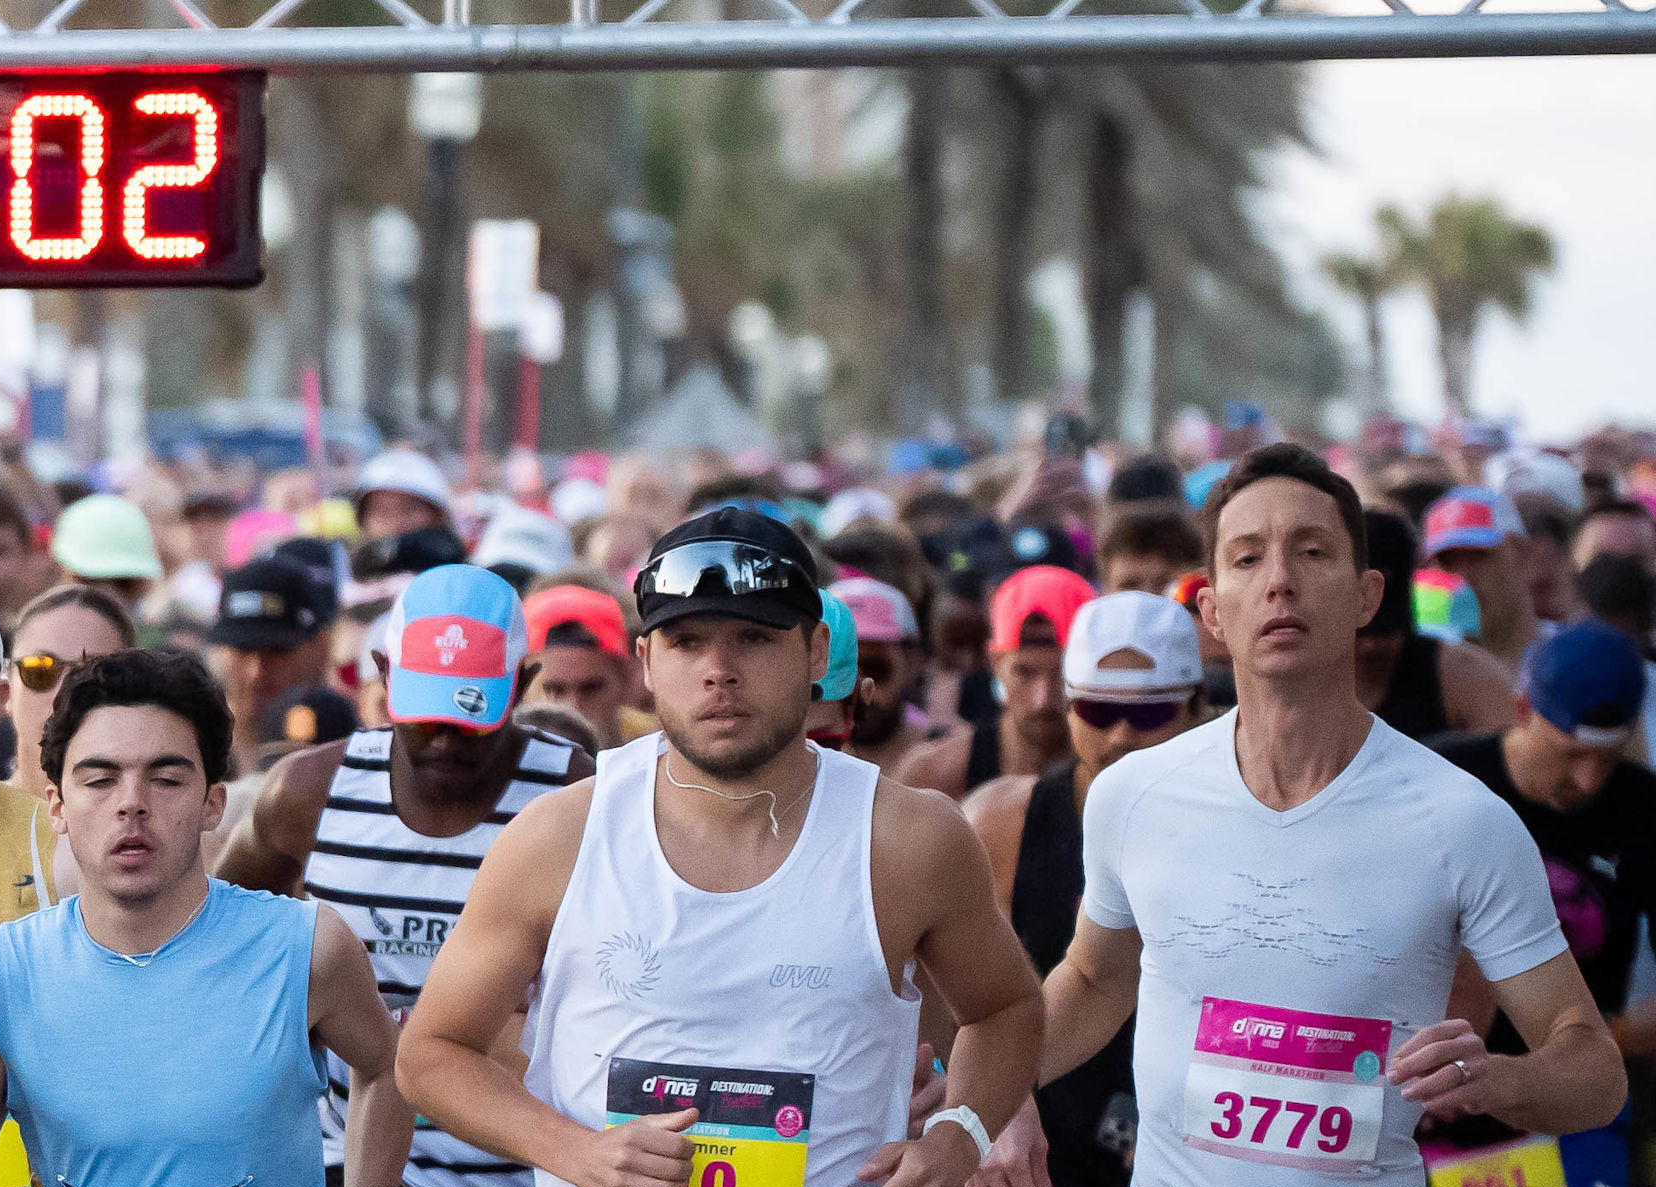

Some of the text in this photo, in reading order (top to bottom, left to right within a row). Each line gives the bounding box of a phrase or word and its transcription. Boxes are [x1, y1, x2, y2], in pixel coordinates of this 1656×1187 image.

[403, 916, 457, 943] PR
[710, 1080, 774, 1096] DESTINATION:
[1209, 1091, 1354, 1154] 3779
[694, 1142, 737, 1157] mner
